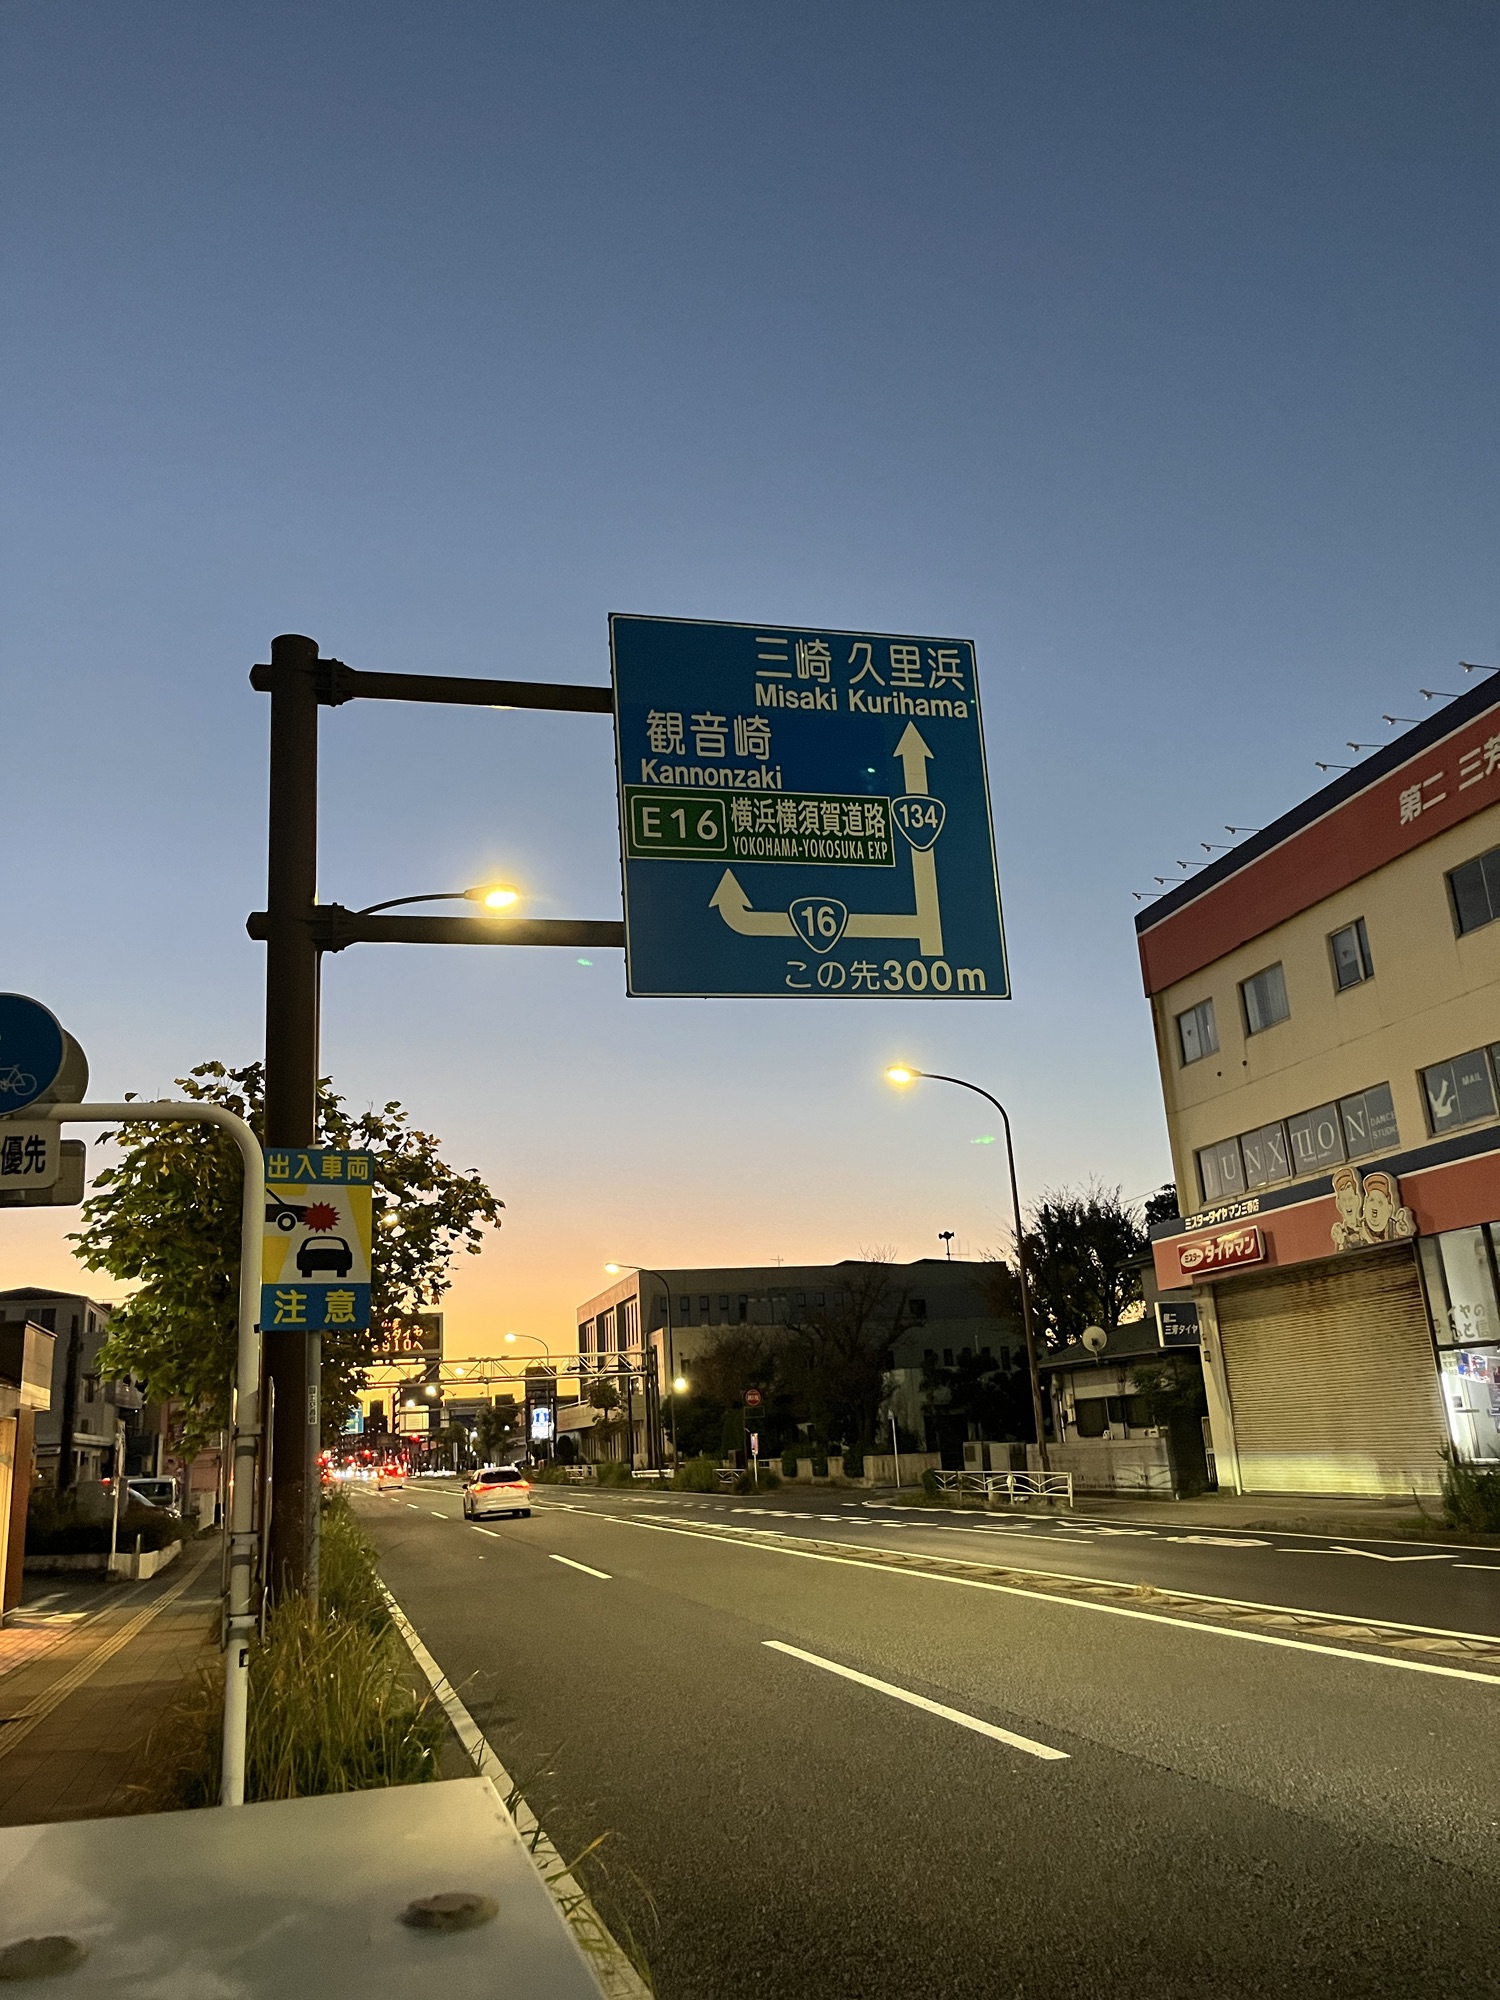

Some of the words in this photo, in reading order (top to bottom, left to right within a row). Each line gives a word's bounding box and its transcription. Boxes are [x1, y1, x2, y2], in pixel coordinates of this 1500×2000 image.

[755, 637, 832, 683] 三崎
[848, 642, 965, 691] 久里浜
[755, 684, 838, 711] Misaki
[848, 689, 969, 718] Kurihama
[646, 709, 772, 760] 観音崎
[641, 759, 783, 789] Kannonzaki
[731, 796, 887, 838] 横浜横須賀道路
[899, 804, 938, 830] 134
[732, 835, 865, 859] YOKOHAMA-YOKOSUKA
[868, 841, 889, 861] EXP
[801, 906, 837, 937] 16
[1461, 1072, 1484, 1086] MAIL
[1, 1135, 45, 1175] 優先
[267, 1153, 369, 1181] 出入車両
[1205, 1236, 1255, 1263] タイヤマン
[274, 1289, 357, 1325] 注意
